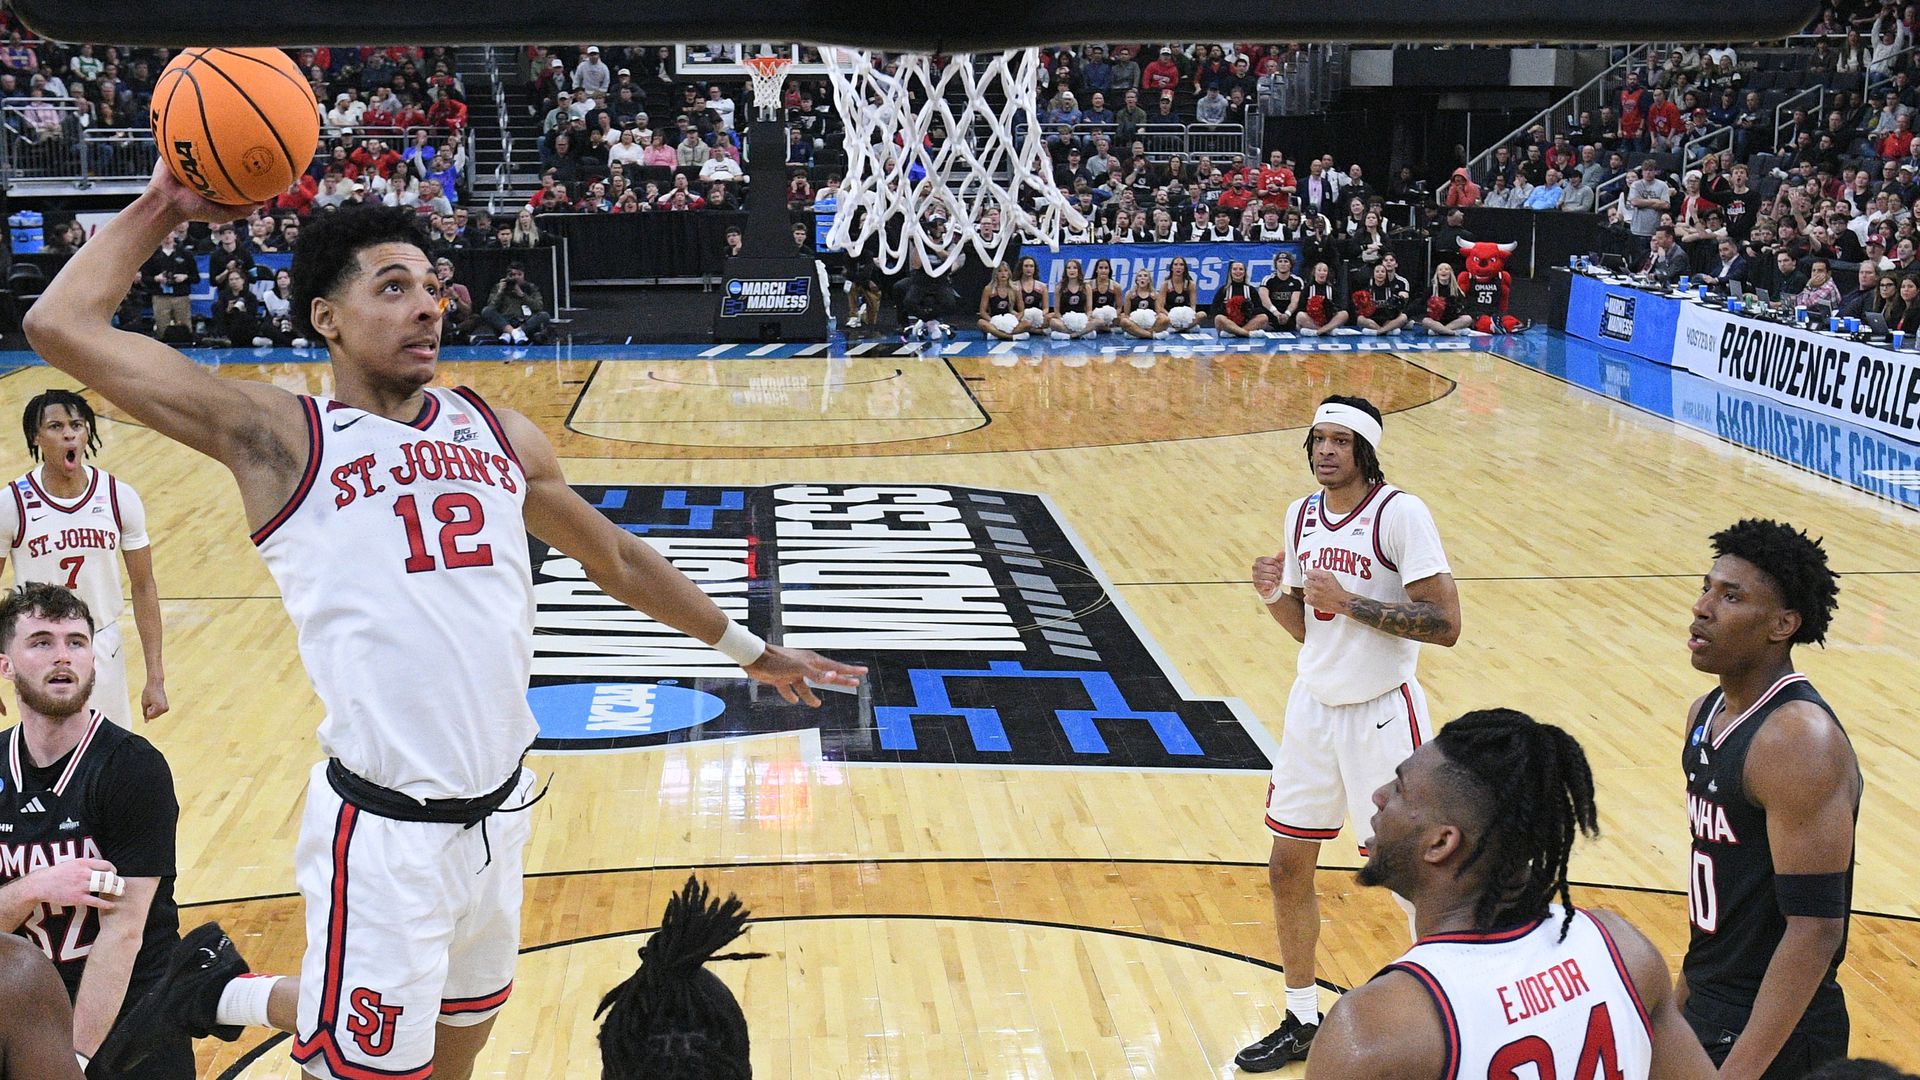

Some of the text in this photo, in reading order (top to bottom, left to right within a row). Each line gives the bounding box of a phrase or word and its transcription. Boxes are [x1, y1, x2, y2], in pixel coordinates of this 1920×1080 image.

[741, 282, 787, 295] MARCH
[747, 295, 808, 309] MADNESS
[1477, 291, 1493, 304] 55
[1718, 322, 1851, 409] PROVIDENCE
[1850, 355, 1920, 431] COLLE
[330, 440, 517, 511] ST. JOHN'S
[28, 528, 116, 558] ST. JOHN'S
[392, 492, 494, 574] 12
[59, 555, 85, 589] 7
[773, 486, 1028, 651] MADNESS
[1312, 547, 1373, 581] JOHN'S
[585, 685, 658, 732] NCAA
[0, 836, 104, 878] MAHA
[1496, 958, 1590, 1025] EJIOFOR
